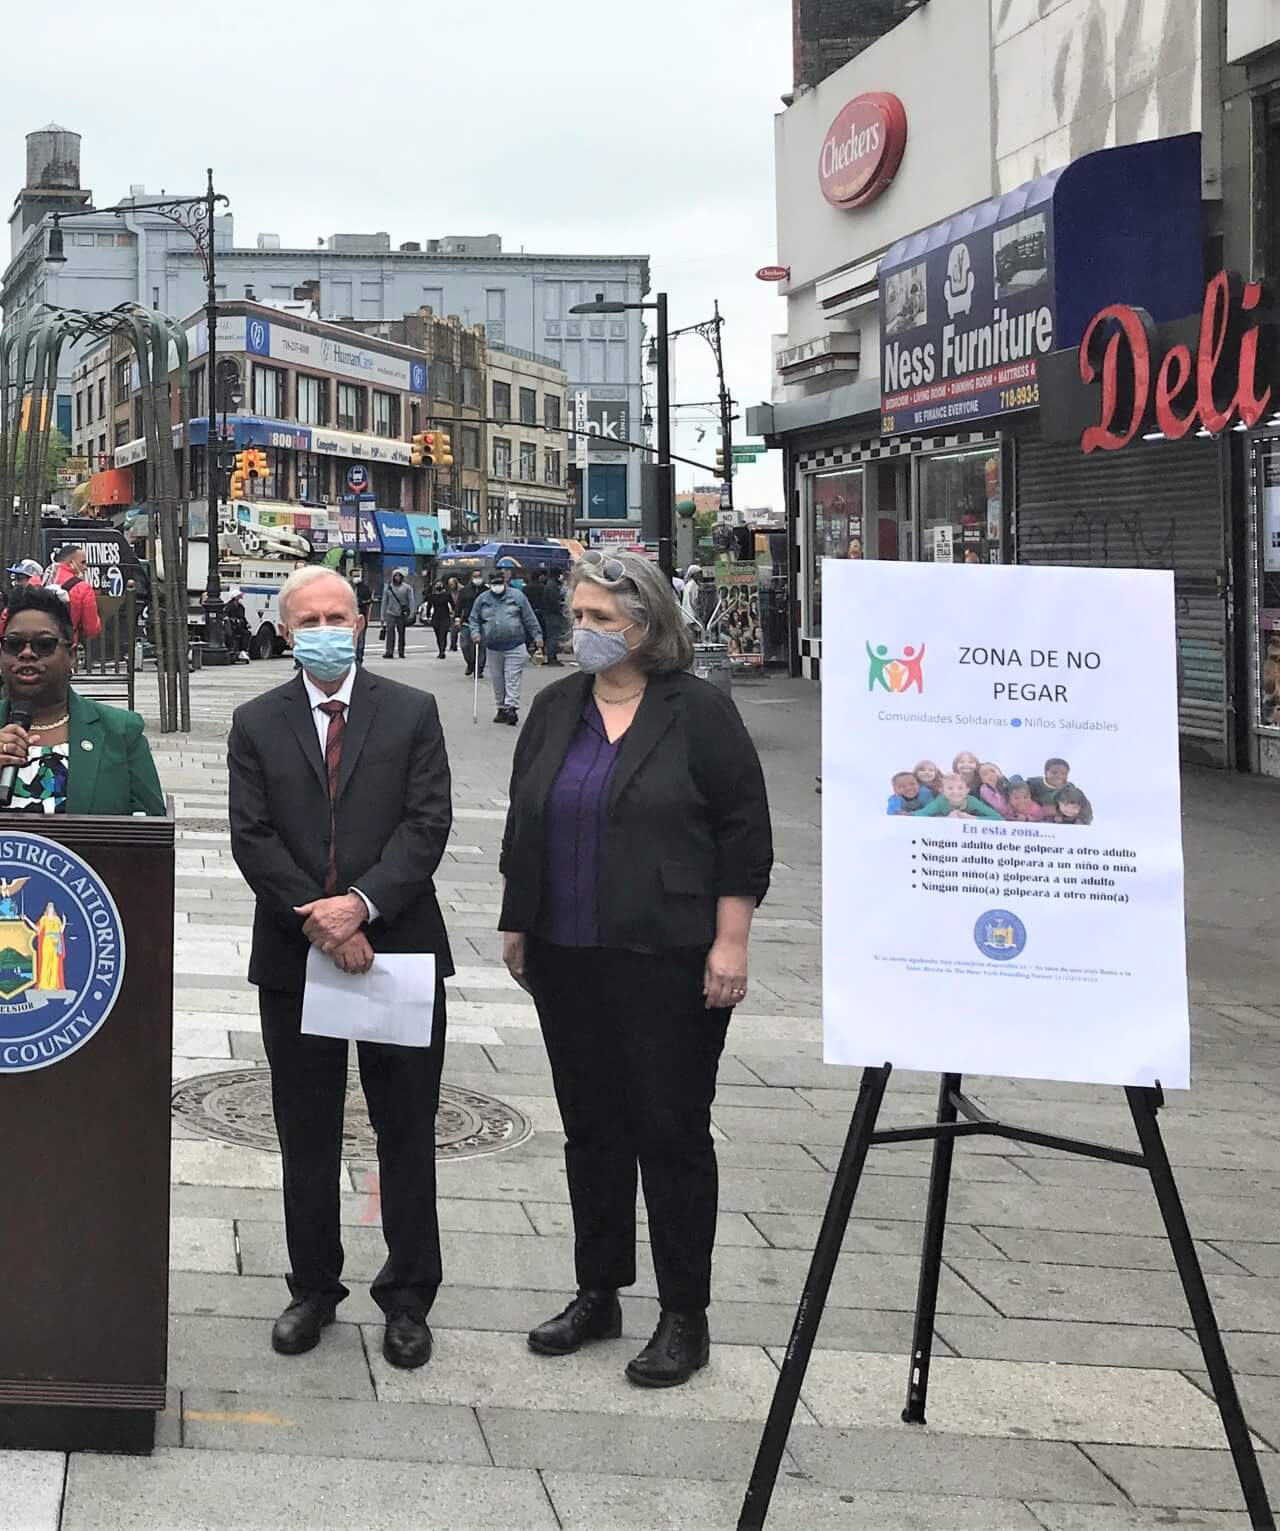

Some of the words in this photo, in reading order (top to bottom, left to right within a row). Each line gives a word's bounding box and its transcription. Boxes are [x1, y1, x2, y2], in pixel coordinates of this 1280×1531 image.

[822, 122, 880, 178] Checkers
[885, 342, 935, 393] Ness
[942, 306, 1052, 378] Furniture
[1080, 269, 1271, 456] Deli
[886, 394, 909, 410] BEDROOM
[913, 388, 930, 404] LIVING
[930, 385, 946, 400] ROOM
[976, 374, 993, 390] ROOM
[998, 364, 1029, 383] MATTRESS
[1030, 362, 1036, 376] &
[914, 412, 923, 424] WE
[924, 404, 948, 422] FINANCE
[948, 400, 980, 417] EVERYONE
[1000, 384, 1040, 409] 718-993-5
[959, 647, 1022, 666] ZONA
[1030, 650, 1059, 668] DE
[1067, 651, 1102, 670] NO
[994, 682, 1068, 702] PEGAR
[878, 711, 953, 724] Comunidades
[955, 714, 1008, 728] Solidarias
[1024, 716, 1056, 729] Niños
[1058, 719, 1119, 732] Saludables
[962, 824, 978, 834] En
[982, 826, 1007, 836] esta
[961, 840, 994, 850] adulto
[996, 842, 1022, 852] debe
[1024, 844, 1064, 855] golpear
[1076, 846, 1100, 857] otro
[1102, 848, 1137, 858] adulto
[962, 854, 994, 866] adulto
[1057, 861, 1071, 870] un
[1102, 864, 1110, 872] o
[1053, 876, 1060, 884] a
[1064, 876, 1078, 884] un
[1080, 876, 1116, 888] adulto
[1054, 890, 1061, 898] a
[1064, 890, 1086, 900] otro
[70, 876, 116, 988] ATTORNEY
[4, 1010, 94, 1064] COUNTY
